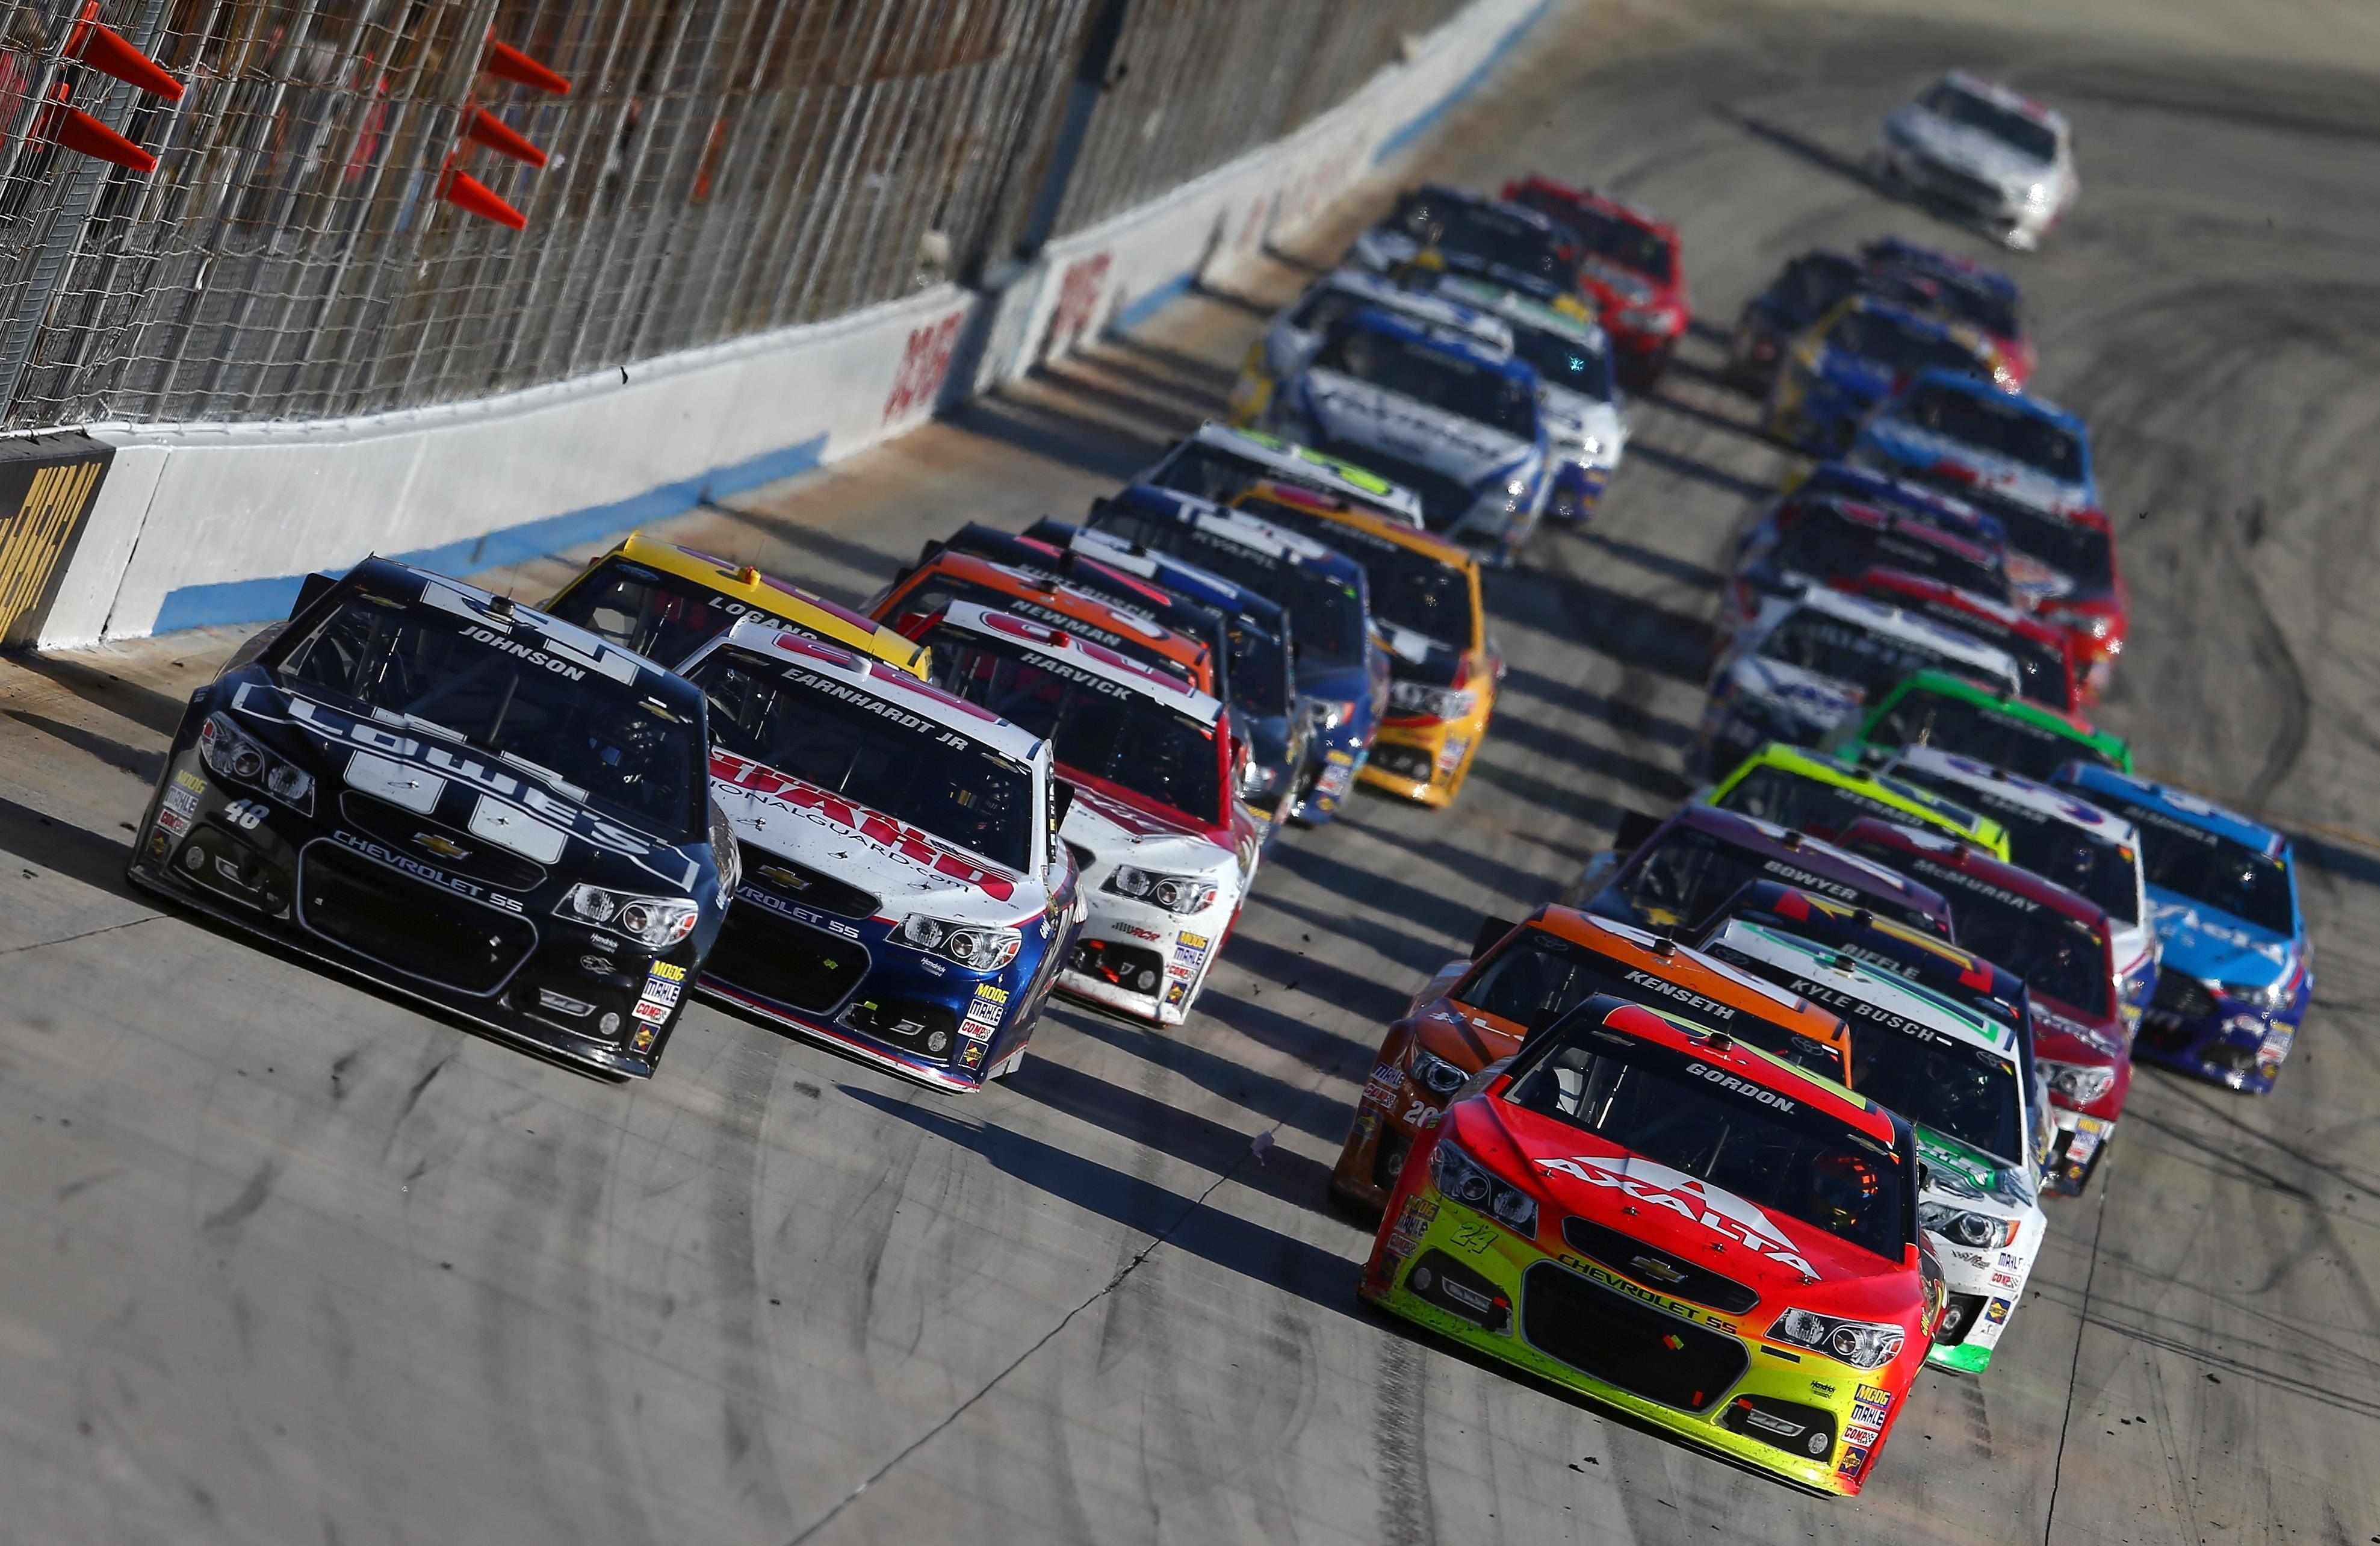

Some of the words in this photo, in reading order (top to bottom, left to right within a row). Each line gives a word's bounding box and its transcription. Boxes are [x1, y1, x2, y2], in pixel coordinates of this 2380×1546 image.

[1011, 600, 1121, 647] NEWMAN
[458, 626, 586, 681] JOHNSON
[1020, 652, 1132, 700] HARVICK
[781, 669, 935, 734] EARNHARDT
[936, 731, 969, 751] JR
[175, 770, 207, 793] MOOG
[288, 697, 650, 854] LOWE'S
[224, 798, 270, 830] 48
[710, 751, 932, 846] TIONAL
[710, 757, 1014, 902] UARD
[710, 780, 969, 893] IONALGUARD.com
[333, 830, 484, 896] CHEVROLET
[488, 892, 524, 913] SS
[1764, 860, 1858, 900] BOWYER
[736, 886, 823, 924] VROLET
[828, 920, 860, 939] SS
[1130, 927, 1160, 942] RCR
[649, 960, 687, 981] MOOG
[1174, 946, 1203, 966] MAHLE
[636, 1003, 661, 1017] COMP
[644, 980, 679, 1003] MAHLE
[974, 983, 1009, 1004] MOOG
[1624, 970, 1735, 1020] KENSETH
[962, 1021, 986, 1036] COMP
[969, 1001, 1003, 1023] MAHLE
[1790, 979, 1852, 1008] KYLE
[1854, 1004, 1935, 1042] BUSCH
[1686, 1063, 1794, 1112] GORDON
[1403, 1101, 1439, 1128] 20
[1449, 1220, 1499, 1255] 24
[1534, 1158, 1823, 1281] AXALTA
[1557, 1253, 1700, 1319] CHEVROLET
[1705, 1314, 1738, 1335] SS
[1810, 1380, 1836, 1393] Hendrick
[1856, 1385, 1892, 1405] MOOG
[1844, 1426, 1868, 1440] COMP
[1851, 1405, 1886, 1427] MAHLE
